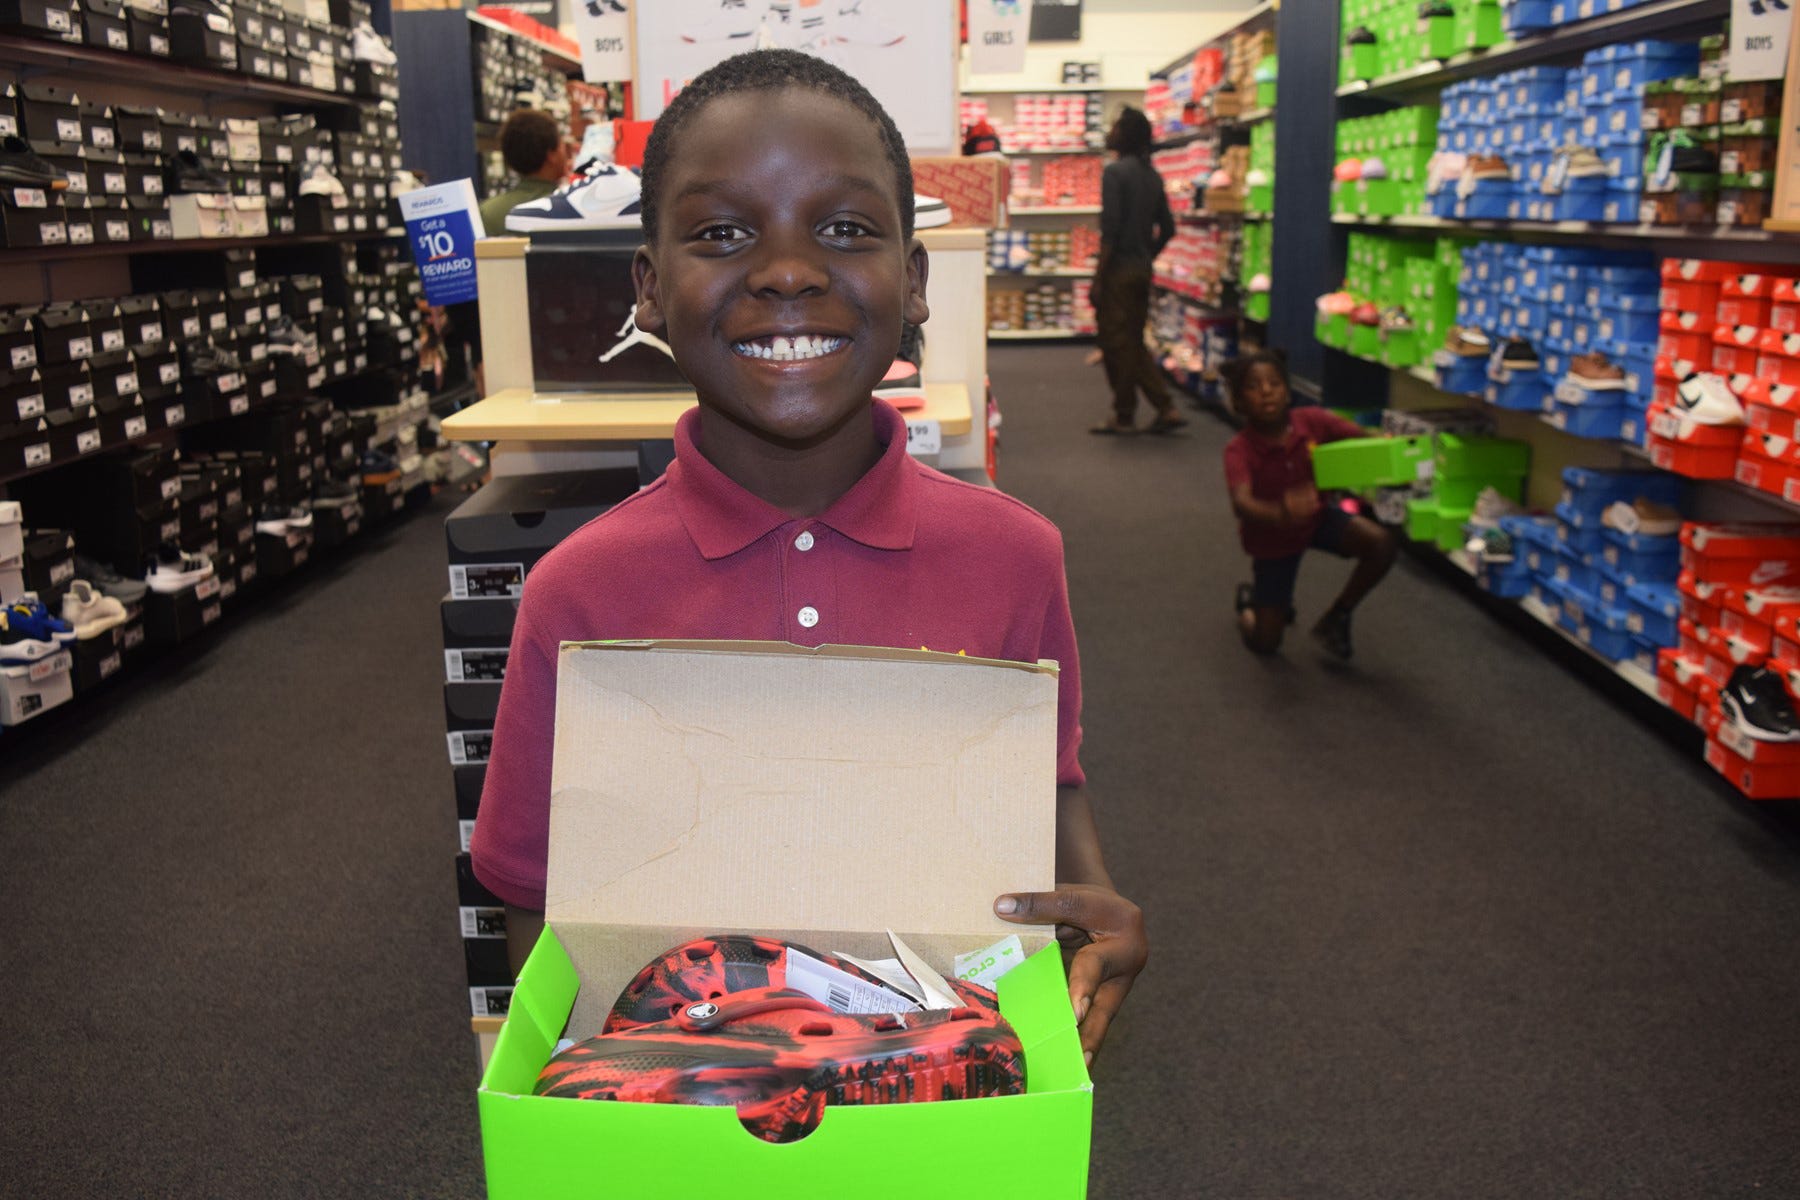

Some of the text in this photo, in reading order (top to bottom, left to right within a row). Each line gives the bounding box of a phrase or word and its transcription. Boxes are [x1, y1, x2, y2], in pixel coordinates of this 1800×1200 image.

[595, 37, 623, 52] BOYS
[983, 30, 1013, 45] GIRLS
[1745, 36, 1773, 50] BOYS
[421, 219, 446, 232] Get a
[418, 231, 454, 259] $10
[422, 258, 472, 276] REWARD
[959, 956, 996, 981] croc
